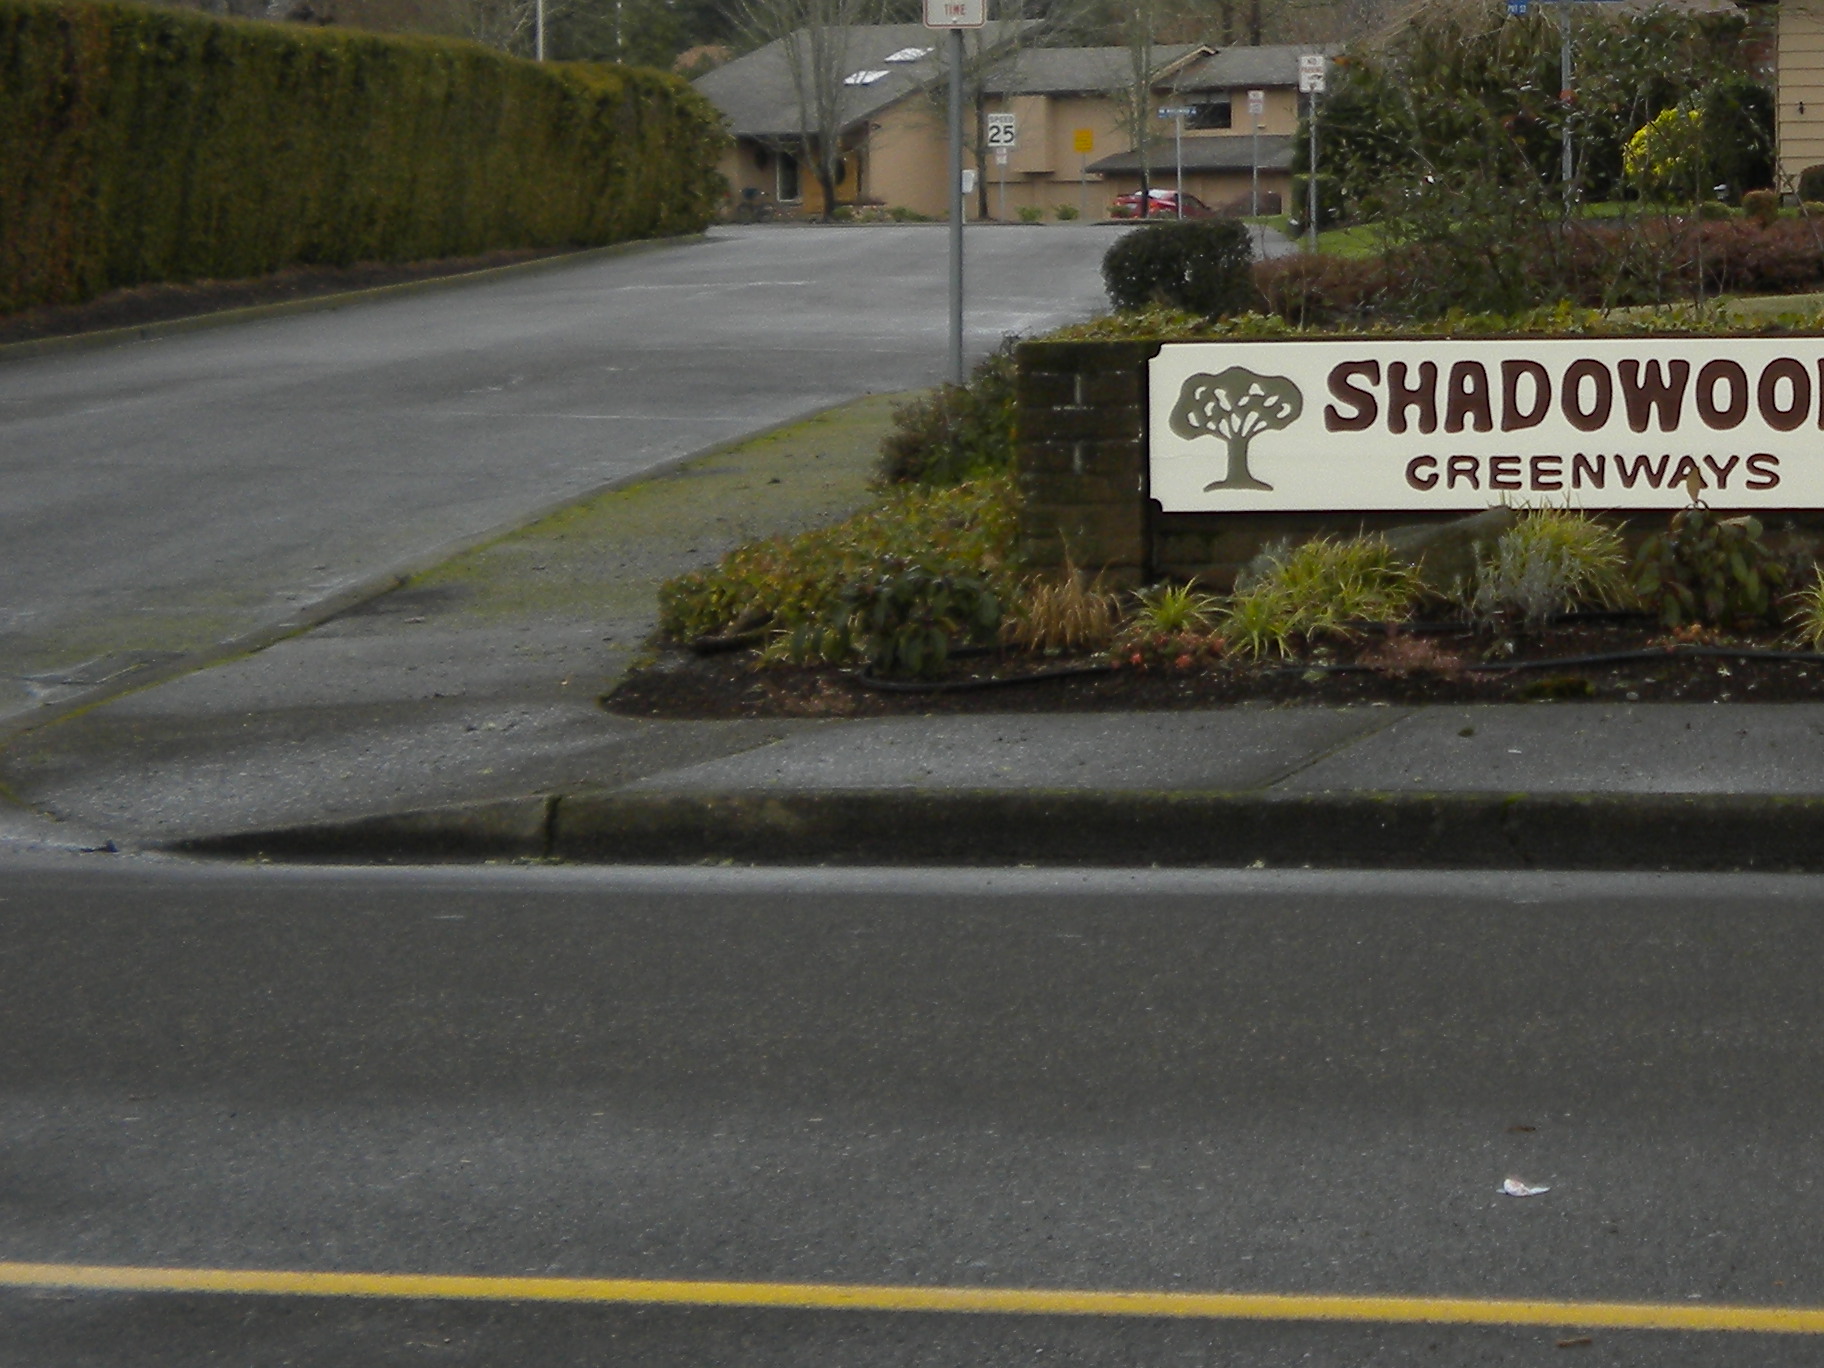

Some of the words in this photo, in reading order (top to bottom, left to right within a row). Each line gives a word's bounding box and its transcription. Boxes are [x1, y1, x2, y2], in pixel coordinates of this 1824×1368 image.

[944, 4, 965, 16] TIME
[990, 125, 1014, 143] 25
[1405, 453, 1782, 491] GREENWAYS
